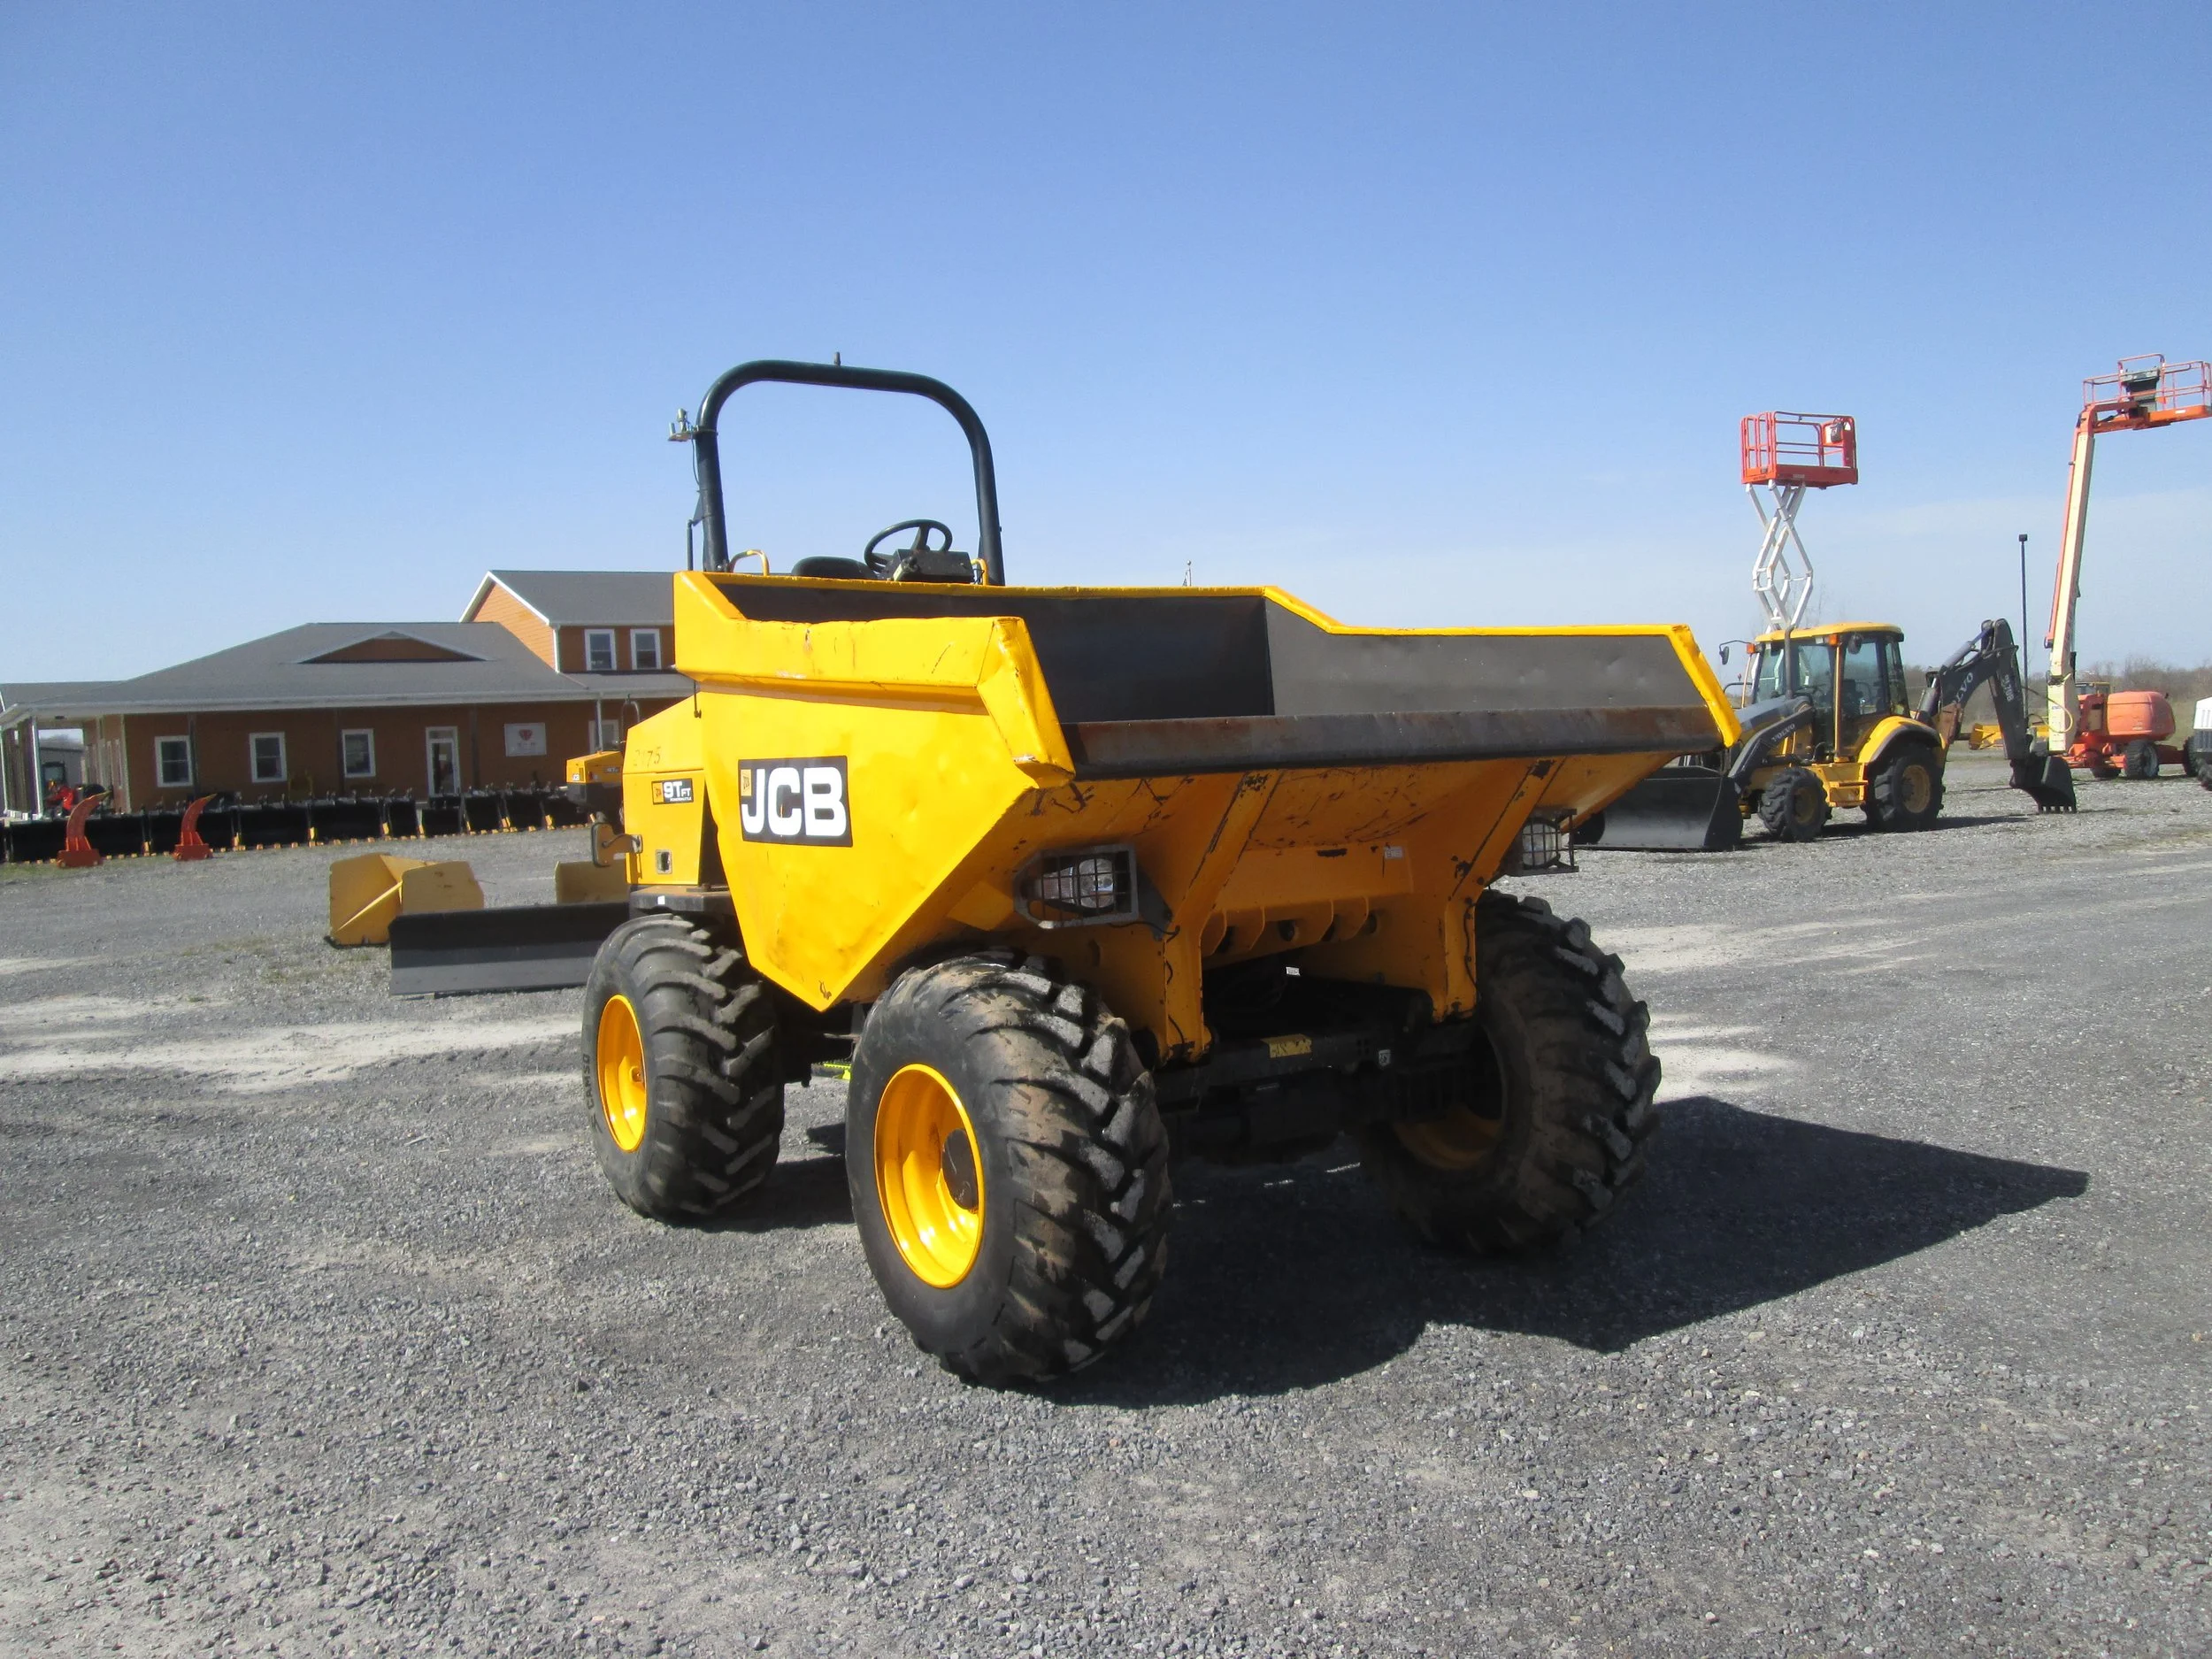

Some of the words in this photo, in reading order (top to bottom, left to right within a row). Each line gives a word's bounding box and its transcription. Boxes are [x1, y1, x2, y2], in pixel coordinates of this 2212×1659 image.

[1770, 723, 1795, 742] VOLVO
[741, 766, 847, 837] JCB
[583, 1052, 595, 1110] CAMSO
